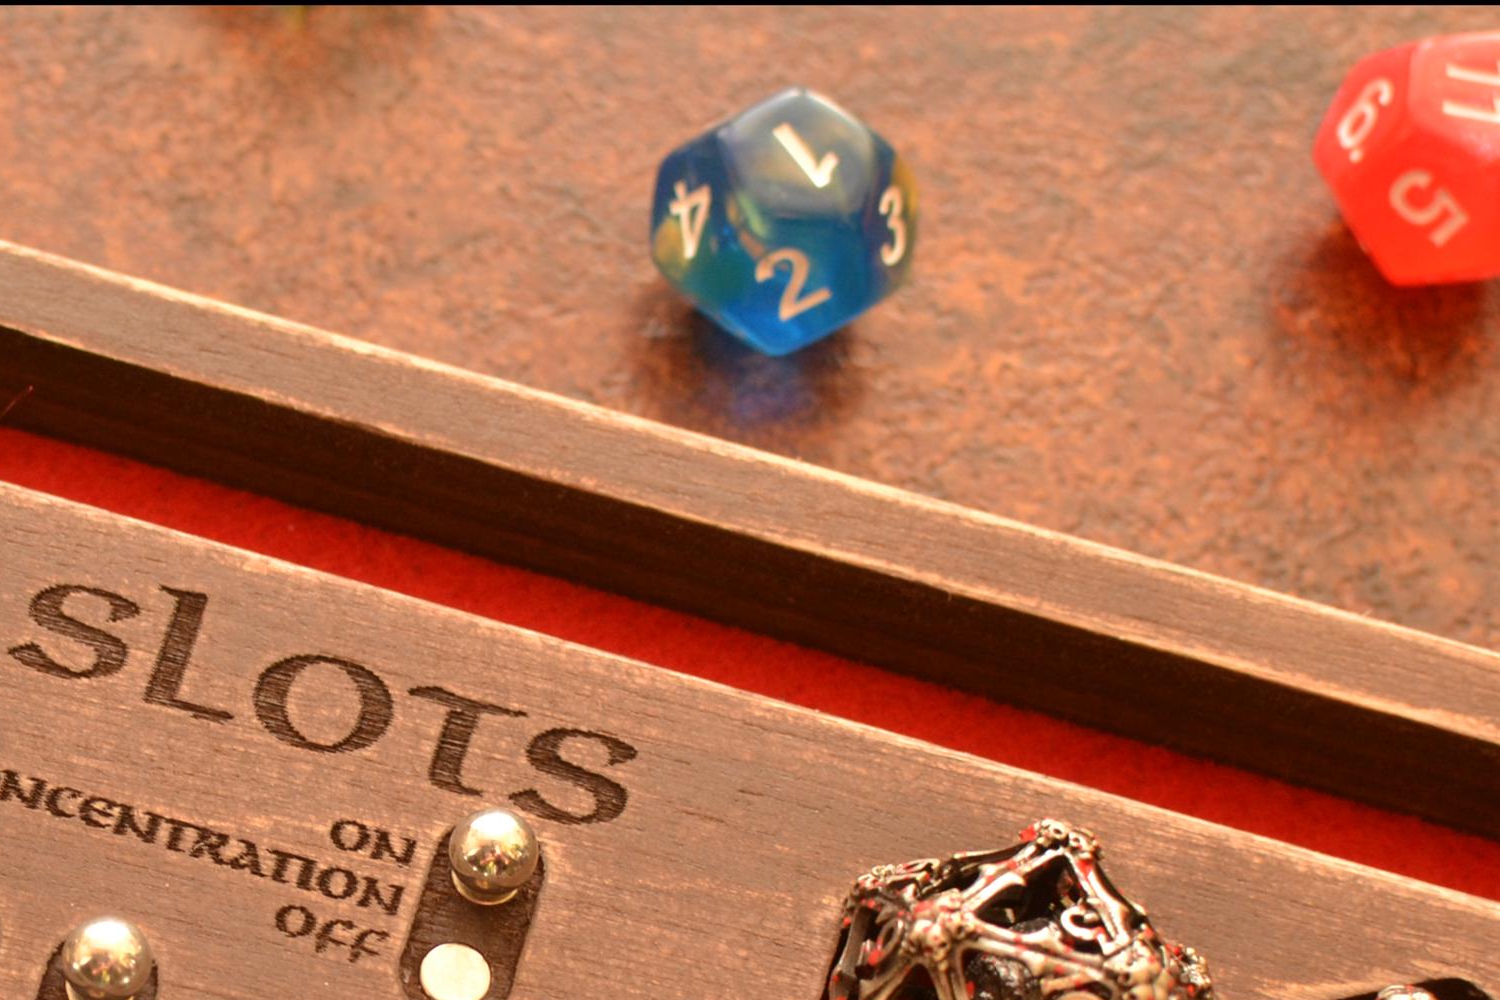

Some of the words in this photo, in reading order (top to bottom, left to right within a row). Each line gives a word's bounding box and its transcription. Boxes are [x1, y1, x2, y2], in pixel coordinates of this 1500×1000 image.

[772, 122, 839, 189] 1
[669, 180, 712, 260] 4
[878, 185, 907, 267] 3
[1388, 169, 1470, 248] 5
[755, 248, 832, 322] 2
[329, 820, 417, 867] ON
